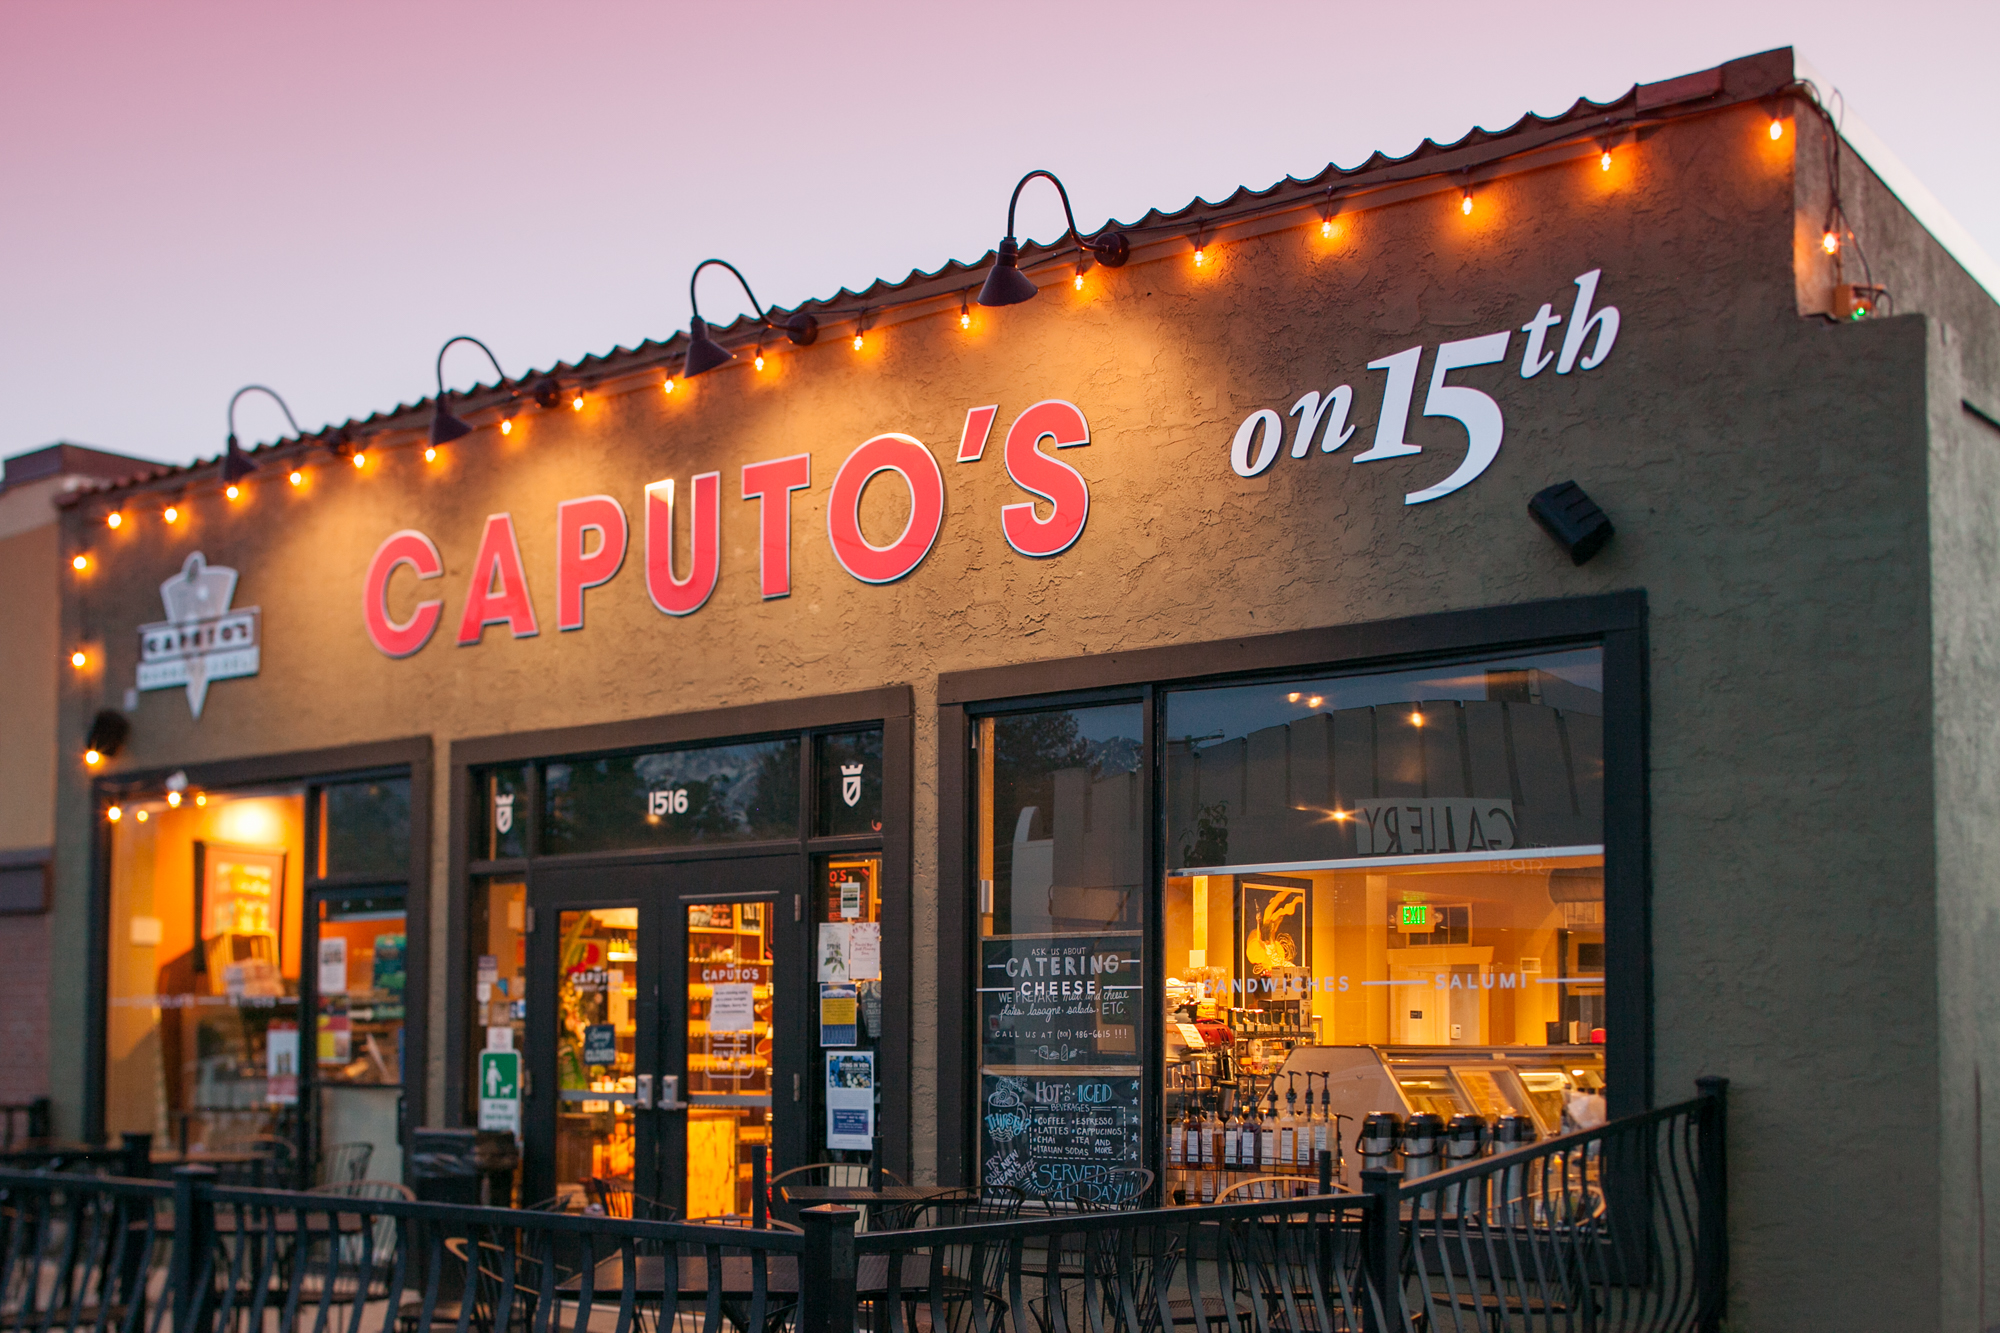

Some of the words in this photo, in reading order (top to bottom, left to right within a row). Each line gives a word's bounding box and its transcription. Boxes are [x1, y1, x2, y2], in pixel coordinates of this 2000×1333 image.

[1230, 384, 1357, 478] on
[1352, 268, 1621, 506] 15th
[363, 398, 1092, 660] CAPUTO'S
[648, 788, 689, 816] 1516
[1403, 905, 1427, 925] EXIT
[1031, 948, 1047, 956] ASK
[1063, 946, 1087, 955] ABOUT
[1005, 954, 1120, 978] CATERING
[702, 968, 759, 982] CAPUTO'S
[1020, 980, 1096, 996] CHEESE
[1204, 976, 1350, 994] SANDWICHES
[1434, 973, 1527, 990] SALUMI
[999, 991, 1013, 1003] WE
[995, 1030, 1020, 1038] CALL
[1025, 1030, 1037, 1038] US
[1041, 1031, 1053, 1039] AT
[1035, 1081, 1064, 1104] HOT
[1077, 1083, 1112, 1104] ICED
[1050, 1102, 1090, 1113] BEVERAGES
[1037, 1117, 1067, 1126] COFFEE
[1076, 1117, 1114, 1126] ESPRESSO
[1038, 1126, 1069, 1135] LATTES
[1076, 1127, 1122, 1136] CAPPUCINOS
[1075, 1136, 1090, 1145] TEA
[1094, 1138, 1111, 1147] AND
[1037, 1145, 1064, 1154] ITALIAN
[1064, 1146, 1089, 1156] SODAS
[1094, 1146, 1114, 1155] MORE
[985, 1150, 1003, 1170] TRY
[985, 1166, 1002, 1184] OUR
[1000, 1149, 1019, 1170] NEW
[1014, 1157, 1038, 1182] COFFEE
[1033, 1163, 1108, 1189] SERVED
